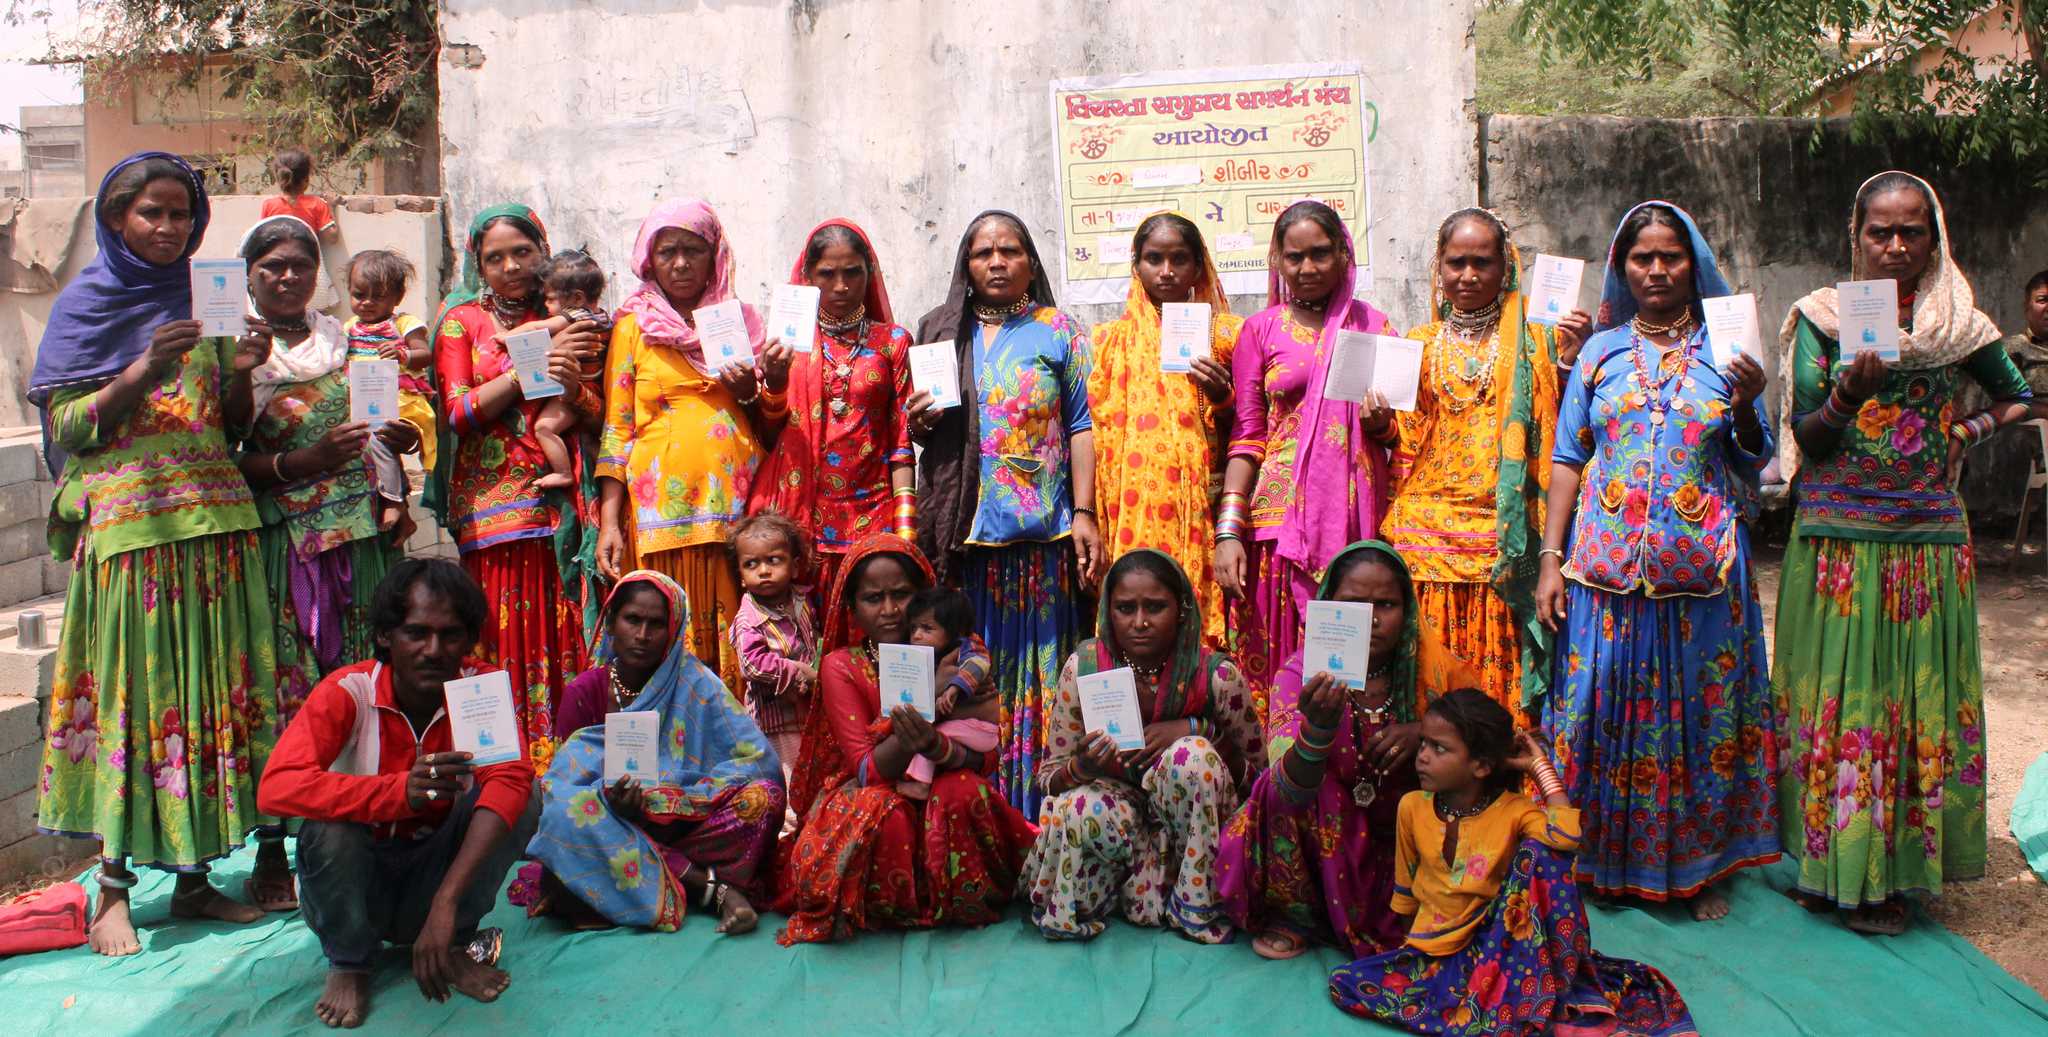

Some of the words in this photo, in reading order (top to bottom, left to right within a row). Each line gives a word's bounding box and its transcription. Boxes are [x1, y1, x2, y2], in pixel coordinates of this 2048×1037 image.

[1065, 93, 1147, 120] વિચરતા
[1151, 93, 1232, 121] સમુદાય
[1236, 82, 1310, 110] સમર્થન
[1314, 81, 1351, 106] મંચ
[1152, 123, 1268, 147] આયોજીત
[1214, 159, 1271, 182] શીબીર
[1205, 201, 1224, 222] ને
